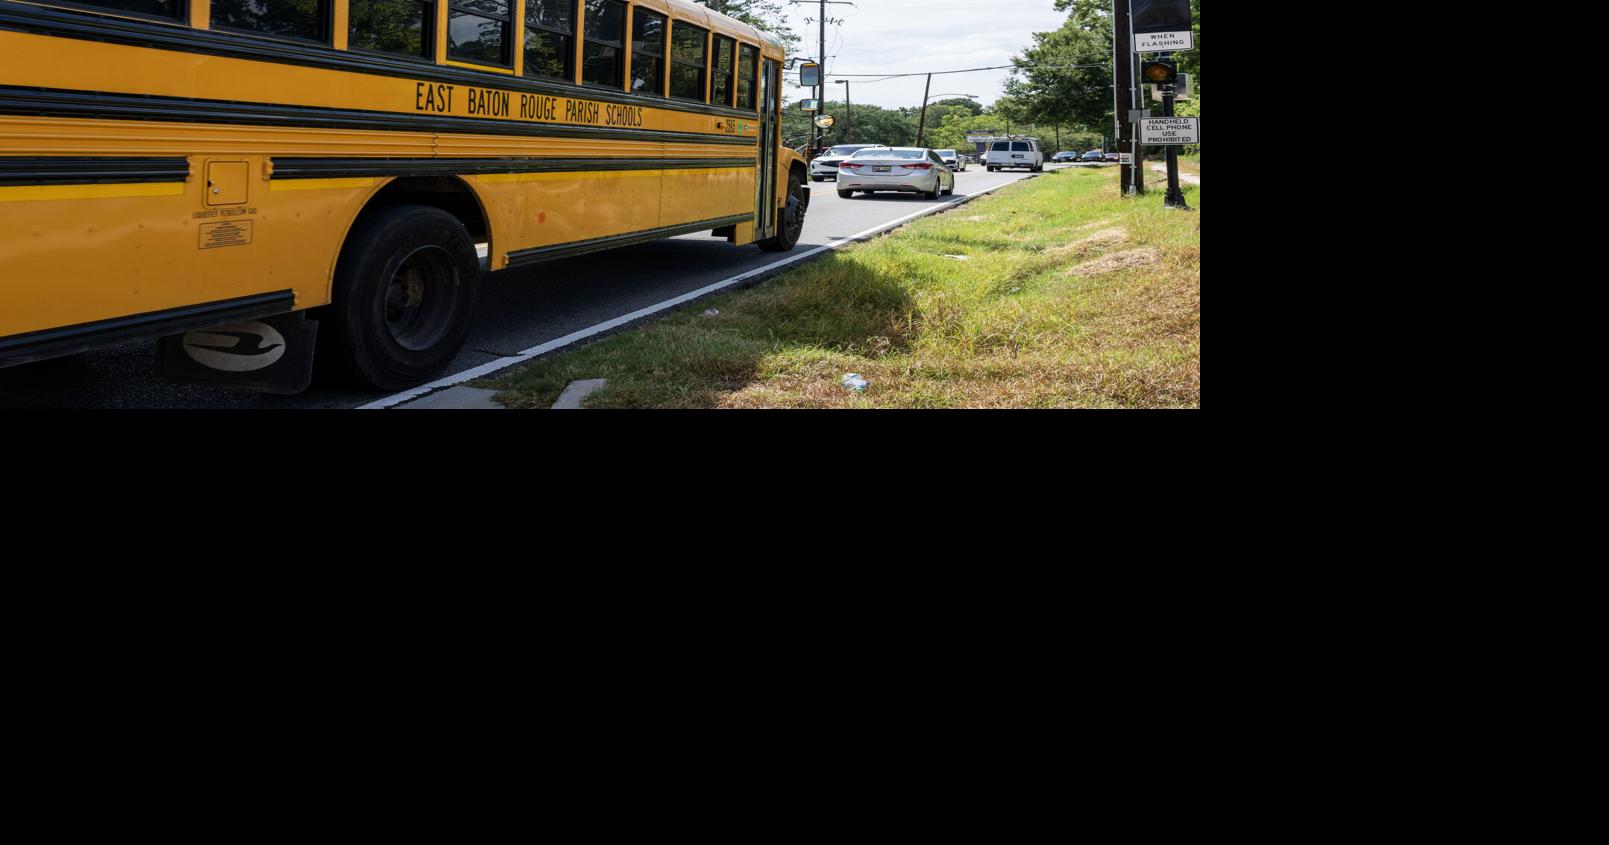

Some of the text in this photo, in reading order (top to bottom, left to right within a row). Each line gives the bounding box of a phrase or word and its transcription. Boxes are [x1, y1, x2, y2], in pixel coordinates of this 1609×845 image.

[1141, 39, 1185, 47] FLASHING
[416, 82, 643, 127] EAST BATON ROUGE PARISH SCHOOLS
